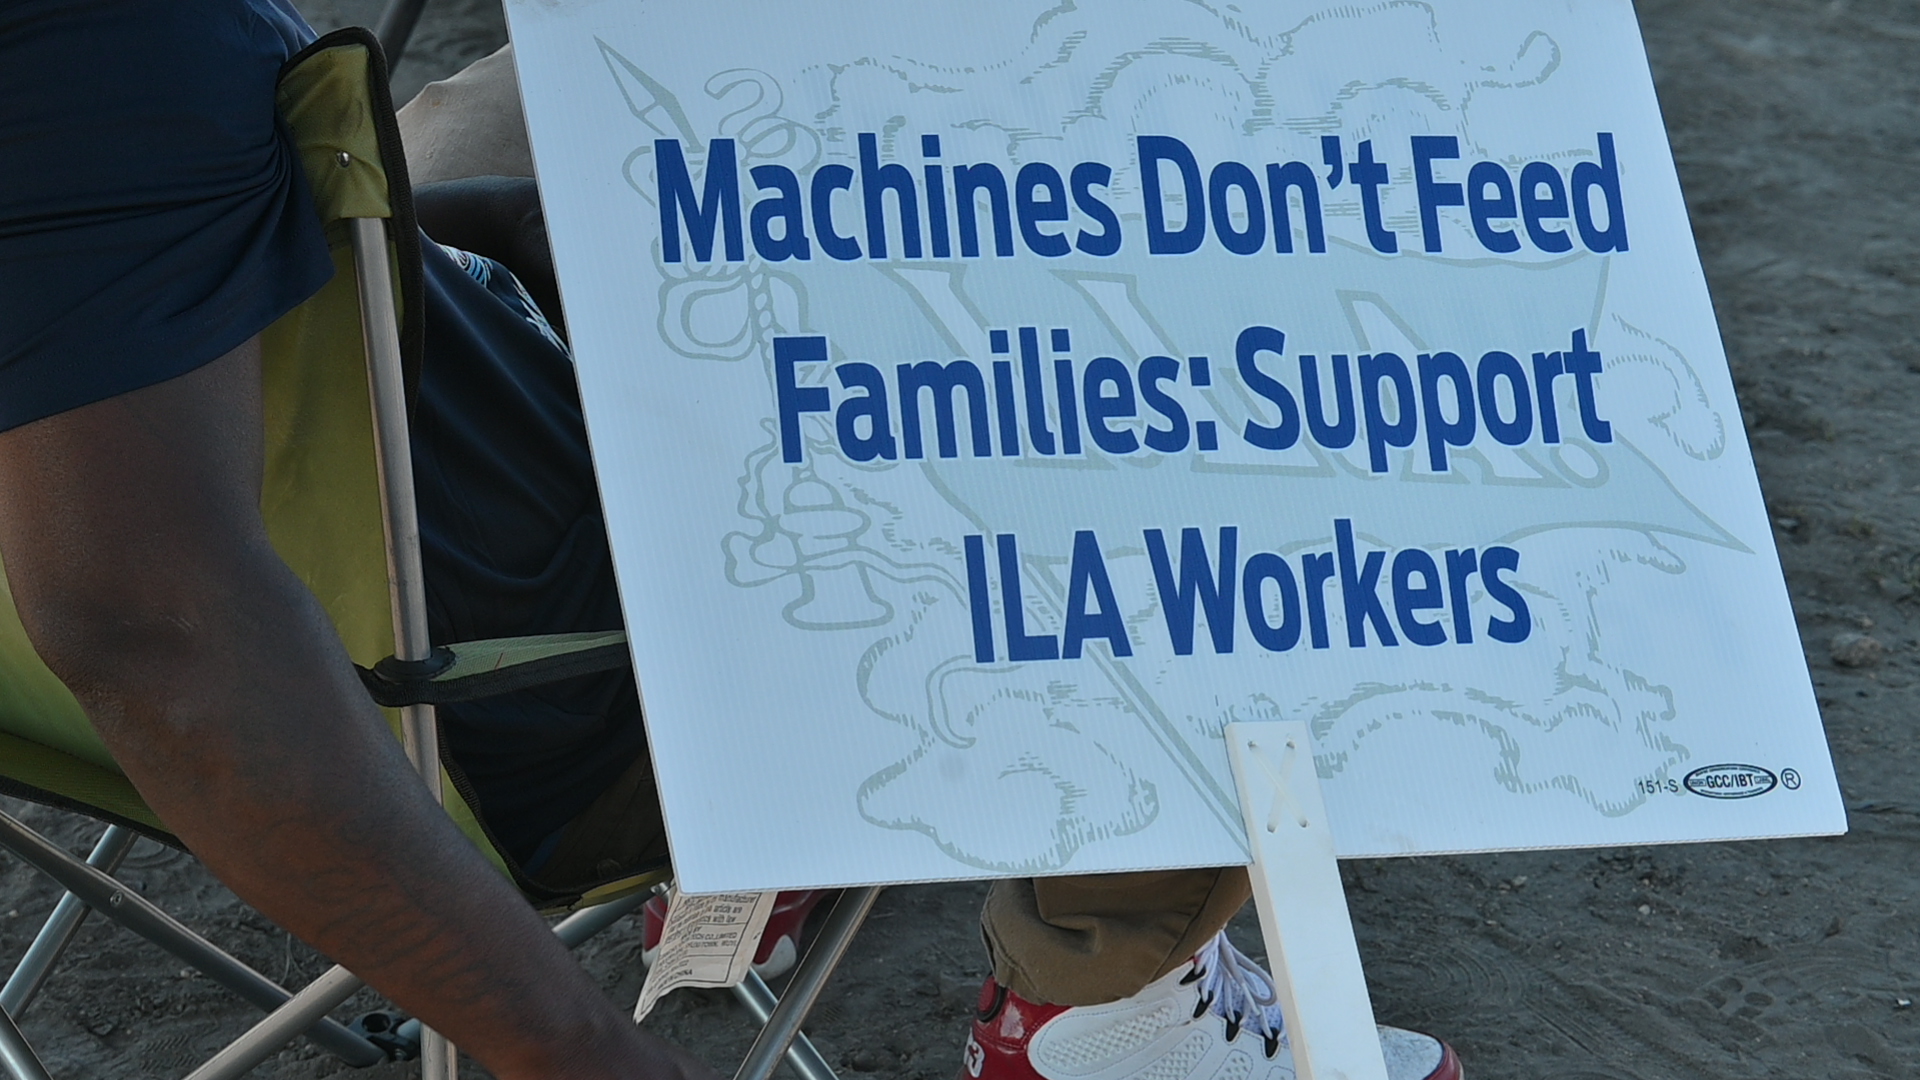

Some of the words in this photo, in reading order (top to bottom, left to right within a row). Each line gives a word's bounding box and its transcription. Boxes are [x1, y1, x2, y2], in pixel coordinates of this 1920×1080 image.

[653, 132, 1121, 263] Machines
[1136, 134, 1396, 256] Don’t
[1411, 132, 1630, 254] Feed
[772, 326, 1219, 464] Families:
[1235, 325, 1613, 475] Support
[963, 530, 1133, 664] ILA
[1142, 518, 1532, 656] Workers
[1637, 778, 1679, 795] 151-S
[1705, 773, 1754, 789] GCC/IBT
